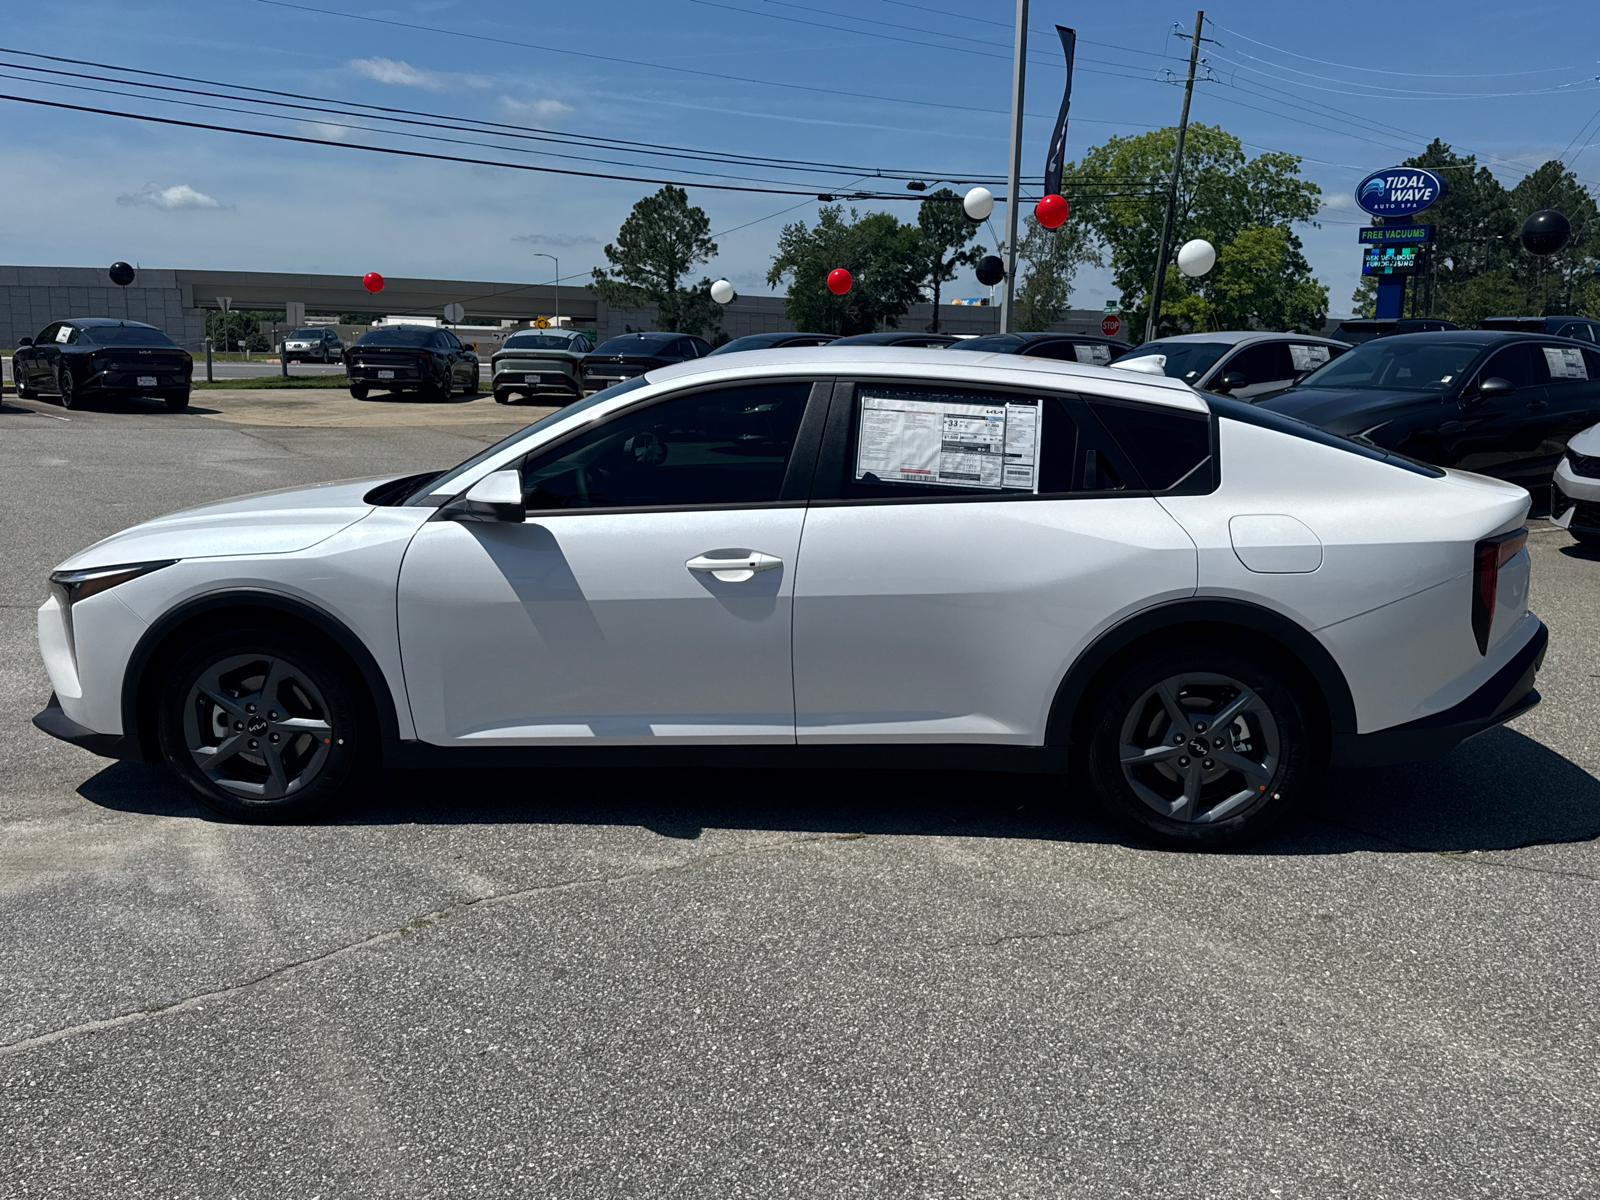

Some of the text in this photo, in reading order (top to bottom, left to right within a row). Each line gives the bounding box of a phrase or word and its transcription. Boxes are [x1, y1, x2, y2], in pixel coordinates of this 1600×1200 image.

[1386, 175, 1425, 189] TIDAL
[1391, 188, 1433, 202] WAVE
[1362, 228, 1426, 240] FREE VACUUMS
[1102, 321, 1119, 330] STOP
[947, 419, 958, 427] 33
